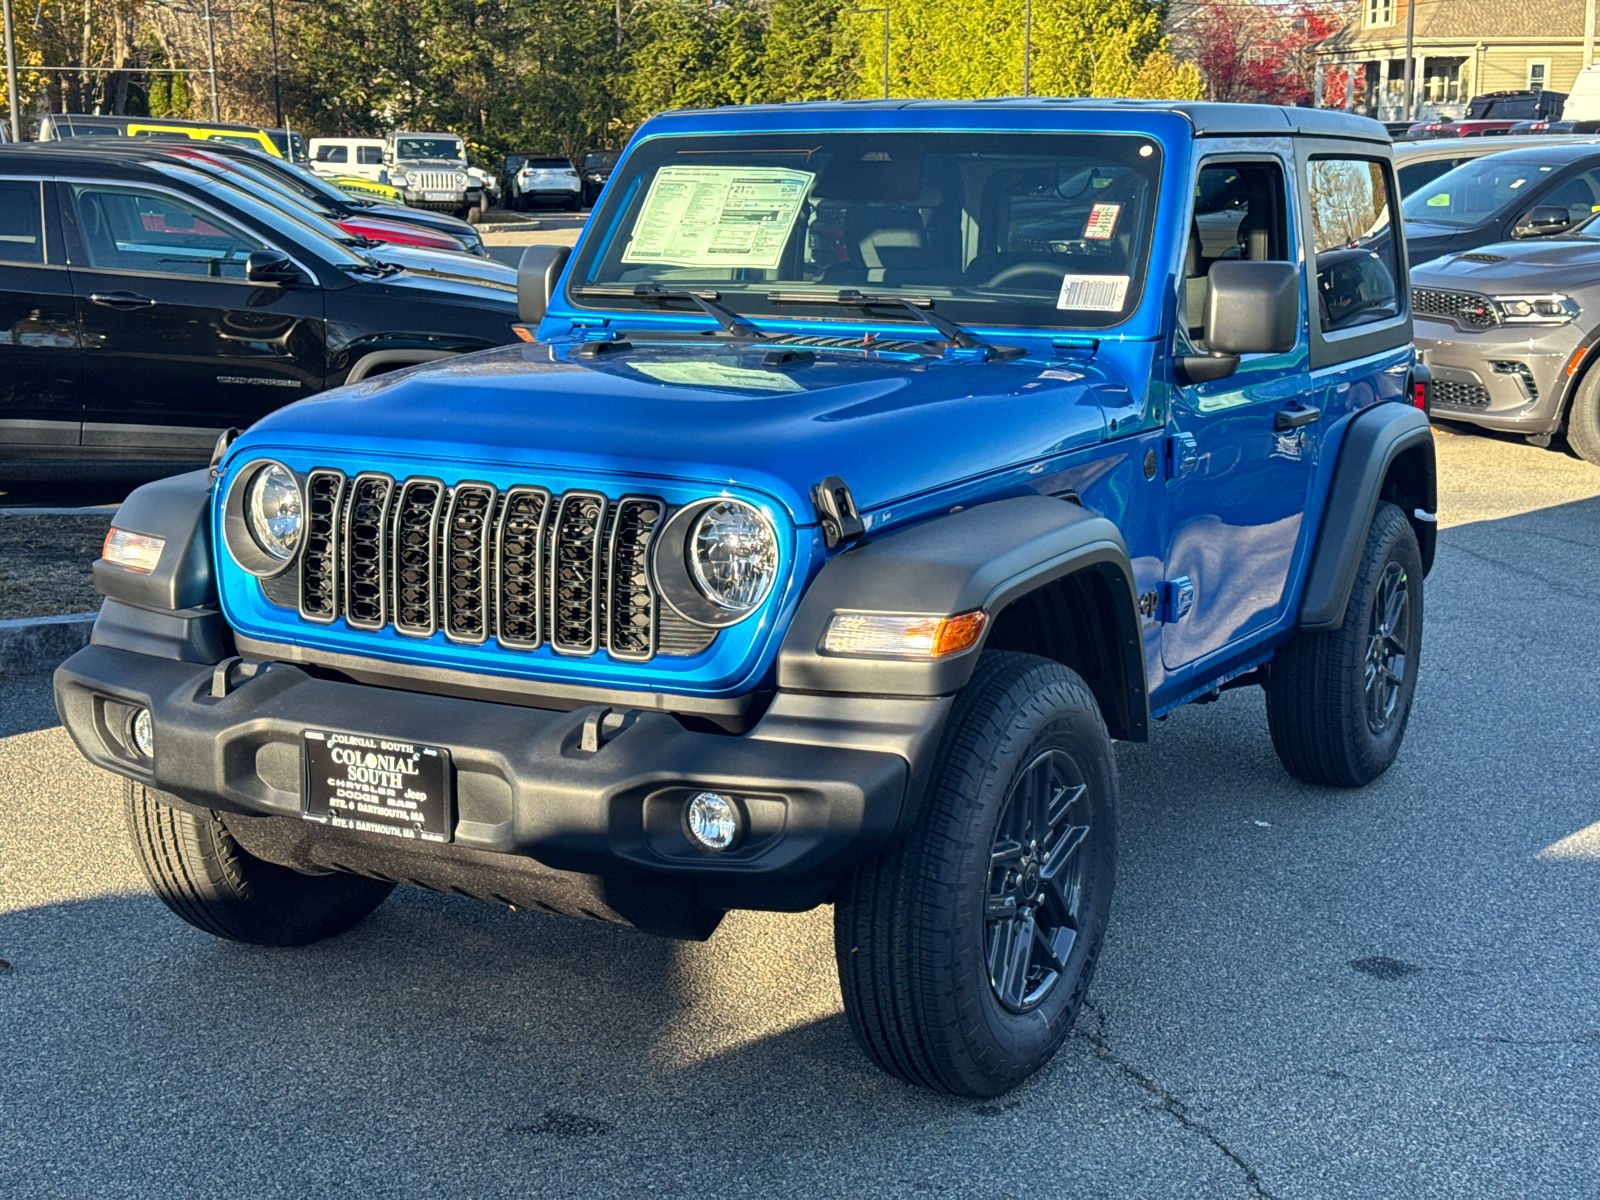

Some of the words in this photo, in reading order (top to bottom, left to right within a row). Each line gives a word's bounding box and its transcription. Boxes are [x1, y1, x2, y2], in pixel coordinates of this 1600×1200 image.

[331, 734, 377, 748] COLONIAL
[380, 741, 414, 753] SOUTH
[331, 747, 419, 775] COLONIAL
[347, 765, 403, 789] SOUTH
[327, 778, 396, 797] CHRYSLER
[404, 788, 427, 802] Jeep
[336, 789, 380, 804] DODGE
[357, 802, 410, 821] DARTMOUTH,
[410, 811, 425, 822] MA
[403, 828, 416, 838] MA
